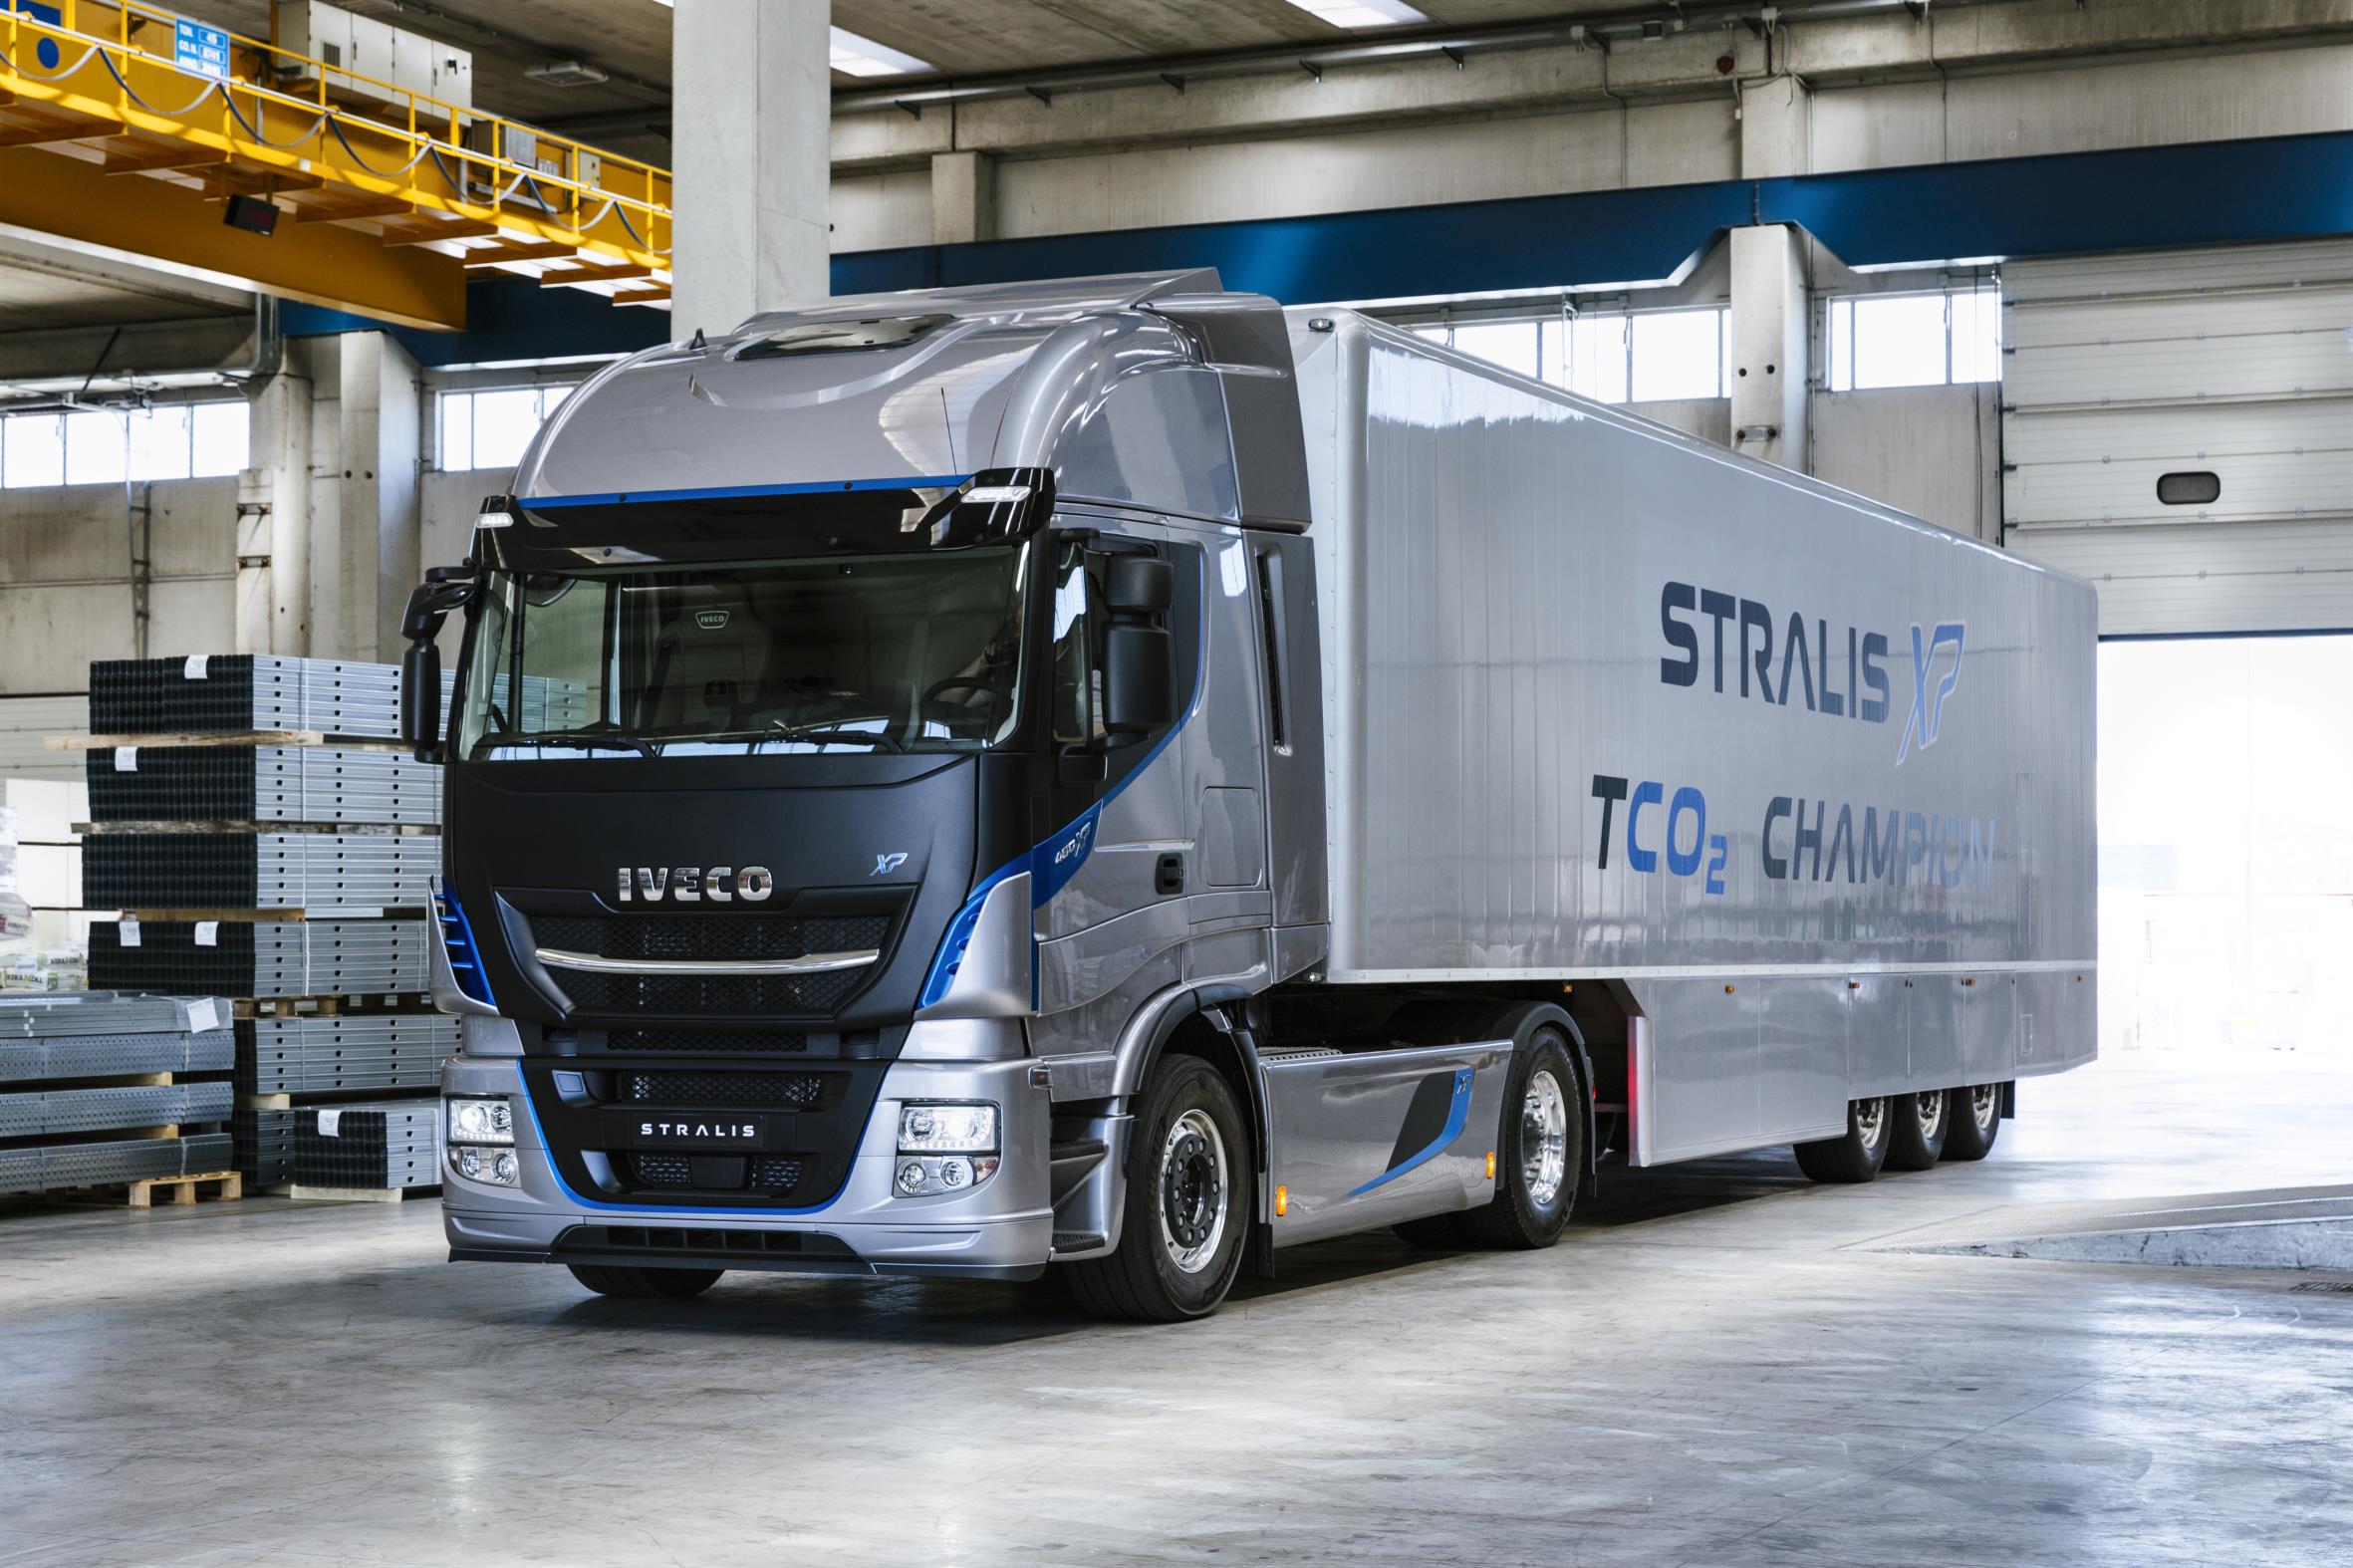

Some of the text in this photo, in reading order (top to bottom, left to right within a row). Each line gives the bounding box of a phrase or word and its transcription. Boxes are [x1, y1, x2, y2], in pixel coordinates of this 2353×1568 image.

[1661, 581, 1966, 768] STRALIS XP
[1762, 796, 1996, 890] CHAMPION
[870, 852, 909, 877] XP
[618, 865, 773, 903] IVECO
[641, 1123, 755, 1138] STRALIS
